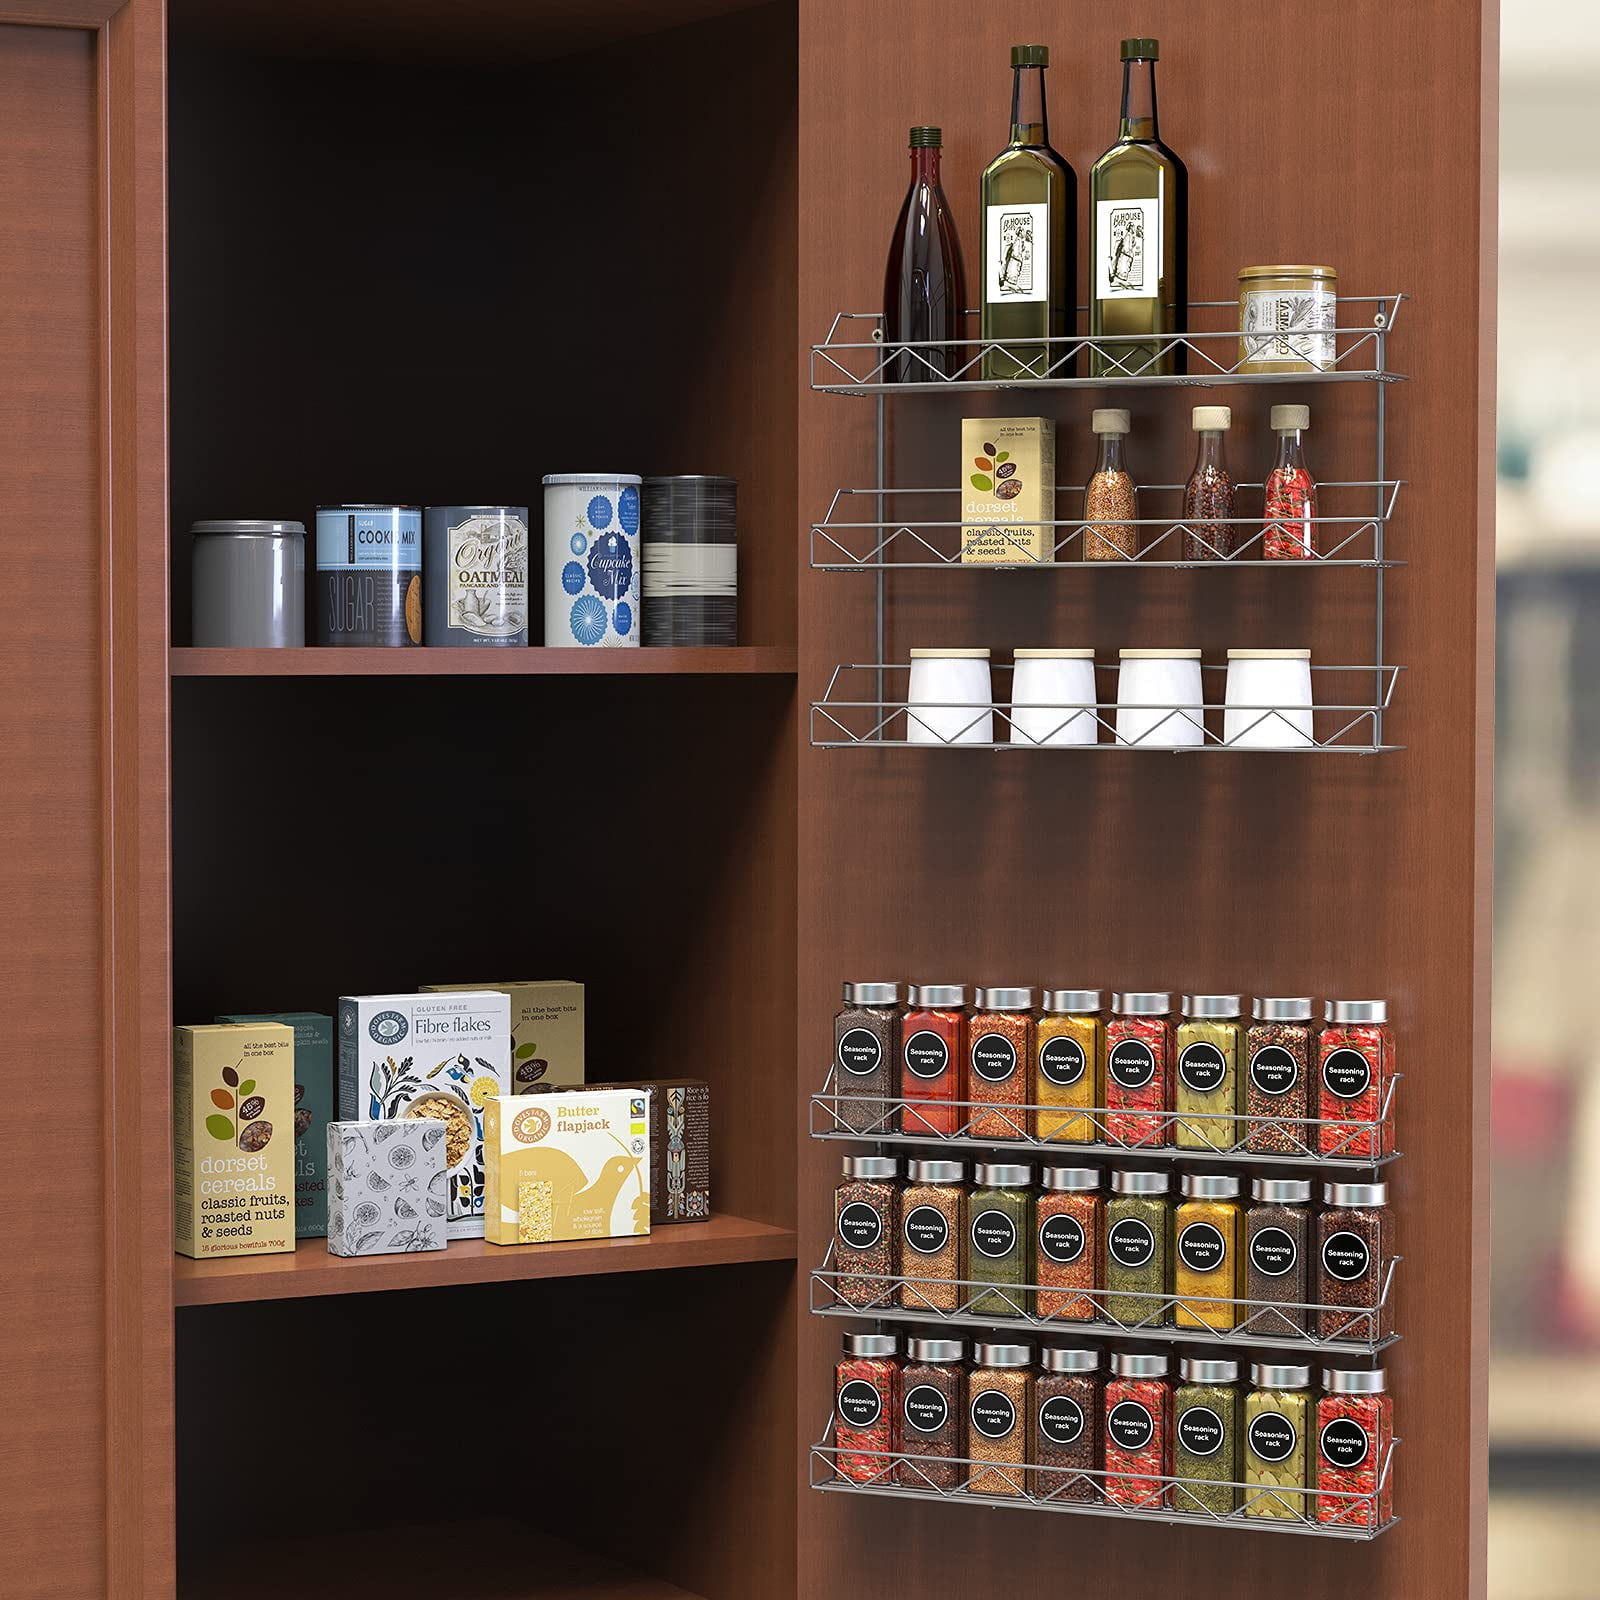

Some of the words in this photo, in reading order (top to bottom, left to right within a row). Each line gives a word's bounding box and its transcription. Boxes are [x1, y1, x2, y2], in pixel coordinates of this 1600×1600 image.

[1121, 212, 1141, 221] HOUSE
[1010, 217, 1031, 226] HOUSE
[966, 500, 1018, 513] dorset
[401, 531, 416, 545] MIX
[977, 547, 1006, 555] seeds
[590, 552, 631, 573] Cupcake
[458, 570, 525, 583] OATMEAL
[603, 569, 628, 587] Mix
[328, 575, 375, 632] SUGAR
[415, 1018, 450, 1034] Fibre
[453, 1016, 491, 1033] flakes
[844, 1045, 876, 1054] Seasoning
[910, 1048, 943, 1057] Seasoning
[853, 1054, 869, 1062] rack
[977, 1051, 1011, 1060] Seasoning
[1046, 1054, 1079, 1063] Seasoning
[919, 1057, 935, 1065] rack
[987, 1060, 1003, 1068] rack
[1115, 1057, 1149, 1067] Seasoning
[1185, 1061, 1220, 1070] Seasoning
[1055, 1063, 1071, 1071] rack
[1125, 1066, 1141, 1074] rack
[1257, 1064, 1292, 1073] Seasoning
[1329, 1067, 1364, 1076] Seasoning
[1195, 1069, 1212, 1077] rack
[1266, 1072, 1283, 1080] rack
[1339, 1075, 1356, 1084] rack
[556, 1106, 600, 1118] Butter
[556, 1118, 610, 1133] flapjack
[200, 1154, 268, 1174] dorset
[200, 1174, 276, 1195] cereals
[201, 1196, 247, 1210] classic
[249, 1193, 290, 1207] fruits,
[201, 1210, 252, 1224] roasted
[255, 1208, 286, 1221] nuts
[844, 1219, 876, 1228] Seasoning
[910, 1223, 943, 1233] Seasoning
[201, 1227, 214, 1238] &
[216, 1224, 253, 1238] seeds
[853, 1228, 869, 1236] rack
[977, 1227, 1010, 1237] Seasoning
[919, 1232, 935, 1240] rack
[987, 1236, 1003, 1244] rack
[1045, 1232, 1079, 1241] Seasoning
[210, 1243, 238, 1252] glorious
[239, 1240, 268, 1249] bowlfuls
[268, 1239, 286, 1247] 700g
[1055, 1240, 1071, 1249] rack
[1115, 1236, 1149, 1246] Seasoning
[1185, 1240, 1219, 1250] Seasoning
[1124, 1245, 1140, 1253] rack
[1194, 1249, 1211, 1257] rack
[1256, 1245, 1291, 1254] Seasoning
[1266, 1254, 1283, 1262] rack
[1328, 1249, 1363, 1259] Seasoning
[1338, 1258, 1355, 1267] rack
[844, 1397, 876, 1406] Seasoning
[853, 1405, 868, 1413] rack
[910, 1402, 942, 1412] Seasoning
[919, 1411, 935, 1419] rack
[977, 1408, 1010, 1417] Seasoning
[986, 1416, 1002, 1425] rack
[1045, 1413, 1078, 1423] Seasoning
[1054, 1422, 1070, 1430] rack
[1114, 1418, 1147, 1429] Seasoning
[1123, 1428, 1140, 1436] rack
[1184, 1424, 1218, 1435] Seasoning
[1194, 1433, 1210, 1442] rack
[1255, 1430, 1289, 1440] Seasoning
[1265, 1439, 1281, 1448] rack
[1327, 1436, 1362, 1446] Seasoning
[1337, 1445, 1353, 1454] rack
